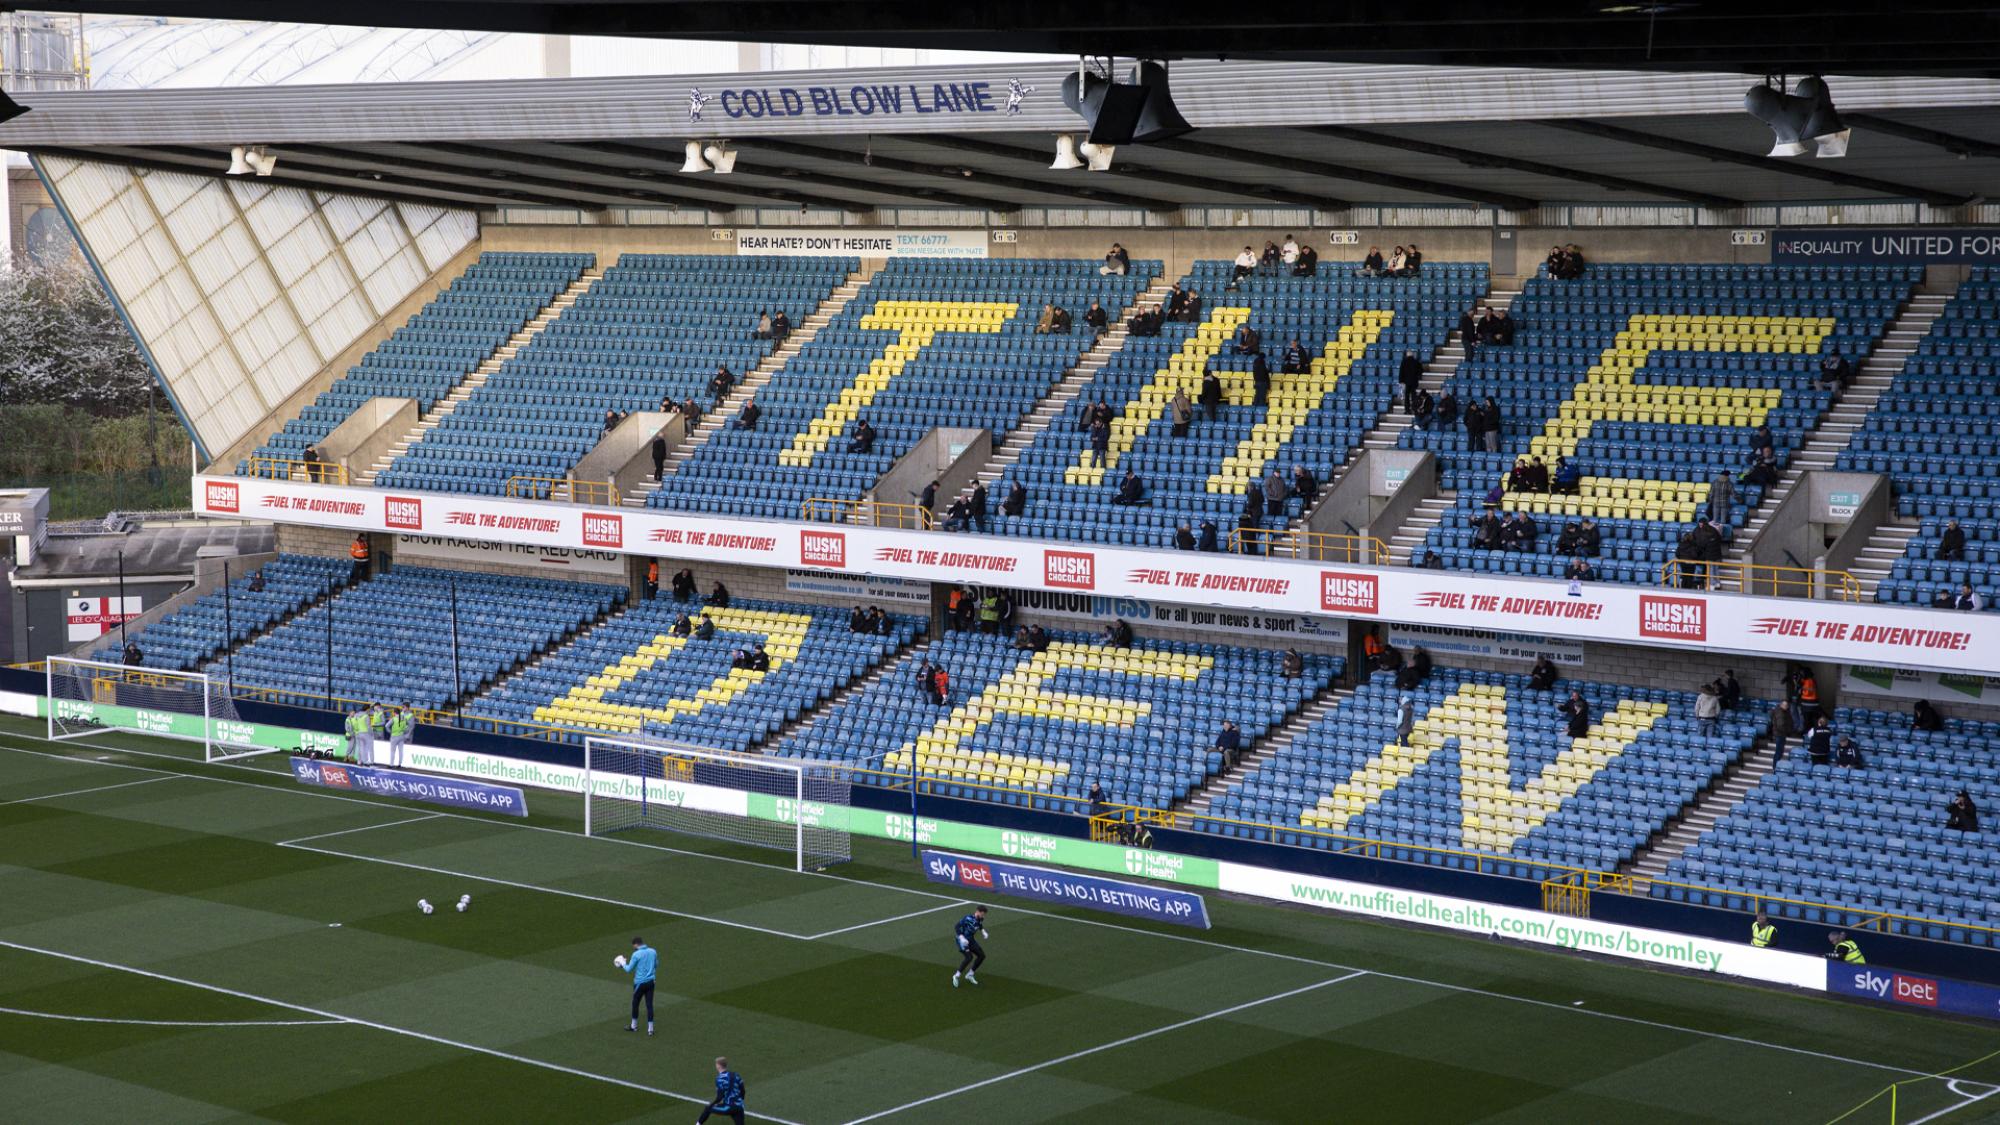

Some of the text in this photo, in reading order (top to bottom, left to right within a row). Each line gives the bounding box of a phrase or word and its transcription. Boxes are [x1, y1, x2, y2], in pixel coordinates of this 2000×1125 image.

[721, 82, 997, 118] COLD BLOW LANE
[740, 237, 892, 250] HEAR HATE? DON'T HESITATE
[896, 235, 918, 244] TEXT
[1778, 241, 1862, 256] INEQUALITY
[1872, 237, 1954, 255] UNITED
[208, 486, 236, 500] HUSKI
[208, 500, 236, 508] CHOCOLATE
[260, 496, 365, 516] FUEL THE ADVENTURE!
[388, 501, 418, 518] HUSKI
[388, 516, 419, 525] CHOCOLATE
[445, 512, 560, 533] FUEL THE ADVENTURE!
[585, 518, 619, 534] HUSKI
[585, 533, 620, 543] CHOCOLATE
[649, 529, 776, 551] FUEL THE ADVENTURE!
[804, 536, 842, 553] HUSKI
[804, 552, 842, 562] CHOCOLATE
[875, 547, 1018, 572] FUEL THE ADVENTURE!
[1048, 556, 1091, 574] HUSKI
[1048, 573, 1091, 584] CHOCOLATE
[1126, 568, 1290, 595] FUEL THE ADVENTURE!
[1326, 578, 1373, 598] HUSKI
[1326, 596, 1374, 609] CHOCOLATE
[1415, 591, 1603, 620] FUEL THE ADVENTURE!
[1155, 606, 1171, 620] for
[1175, 608, 1188, 623] all
[1191, 612, 1215, 626] your
[1220, 614, 1250, 628] news
[1253, 617, 1261, 629] &
[1265, 616, 1295, 632] sport
[1644, 602, 1701, 624] HUSKI
[1645, 622, 1701, 634] CHOCOLATE
[1750, 618, 1971, 651] FUEL THE ADVENTURE!
[1500, 647, 1509, 656] for
[1511, 648, 1519, 656] all
[1564, 654, 1582, 662] sport
[150, 711, 173, 724] Nuffield
[150, 720, 170, 732] Health
[230, 722, 254, 736] Nuffield
[230, 731, 251, 744] Health
[314, 732, 339, 747] Nuffield
[298, 765, 512, 808] sky bet THE UK'S NO.1 BETTING APP
[1021, 832, 1056, 851] Nuffield
[1021, 846, 1051, 861] Health
[1145, 852, 1183, 869] Nuffield
[1145, 864, 1176, 880] Health
[930, 857, 1192, 917] sky bet THE UK'S NO.1 BETTING APP
[1291, 882, 1723, 972] www.nuffieldhealth.com/gyms/bromley
[1854, 971, 1934, 1000] sky bet
